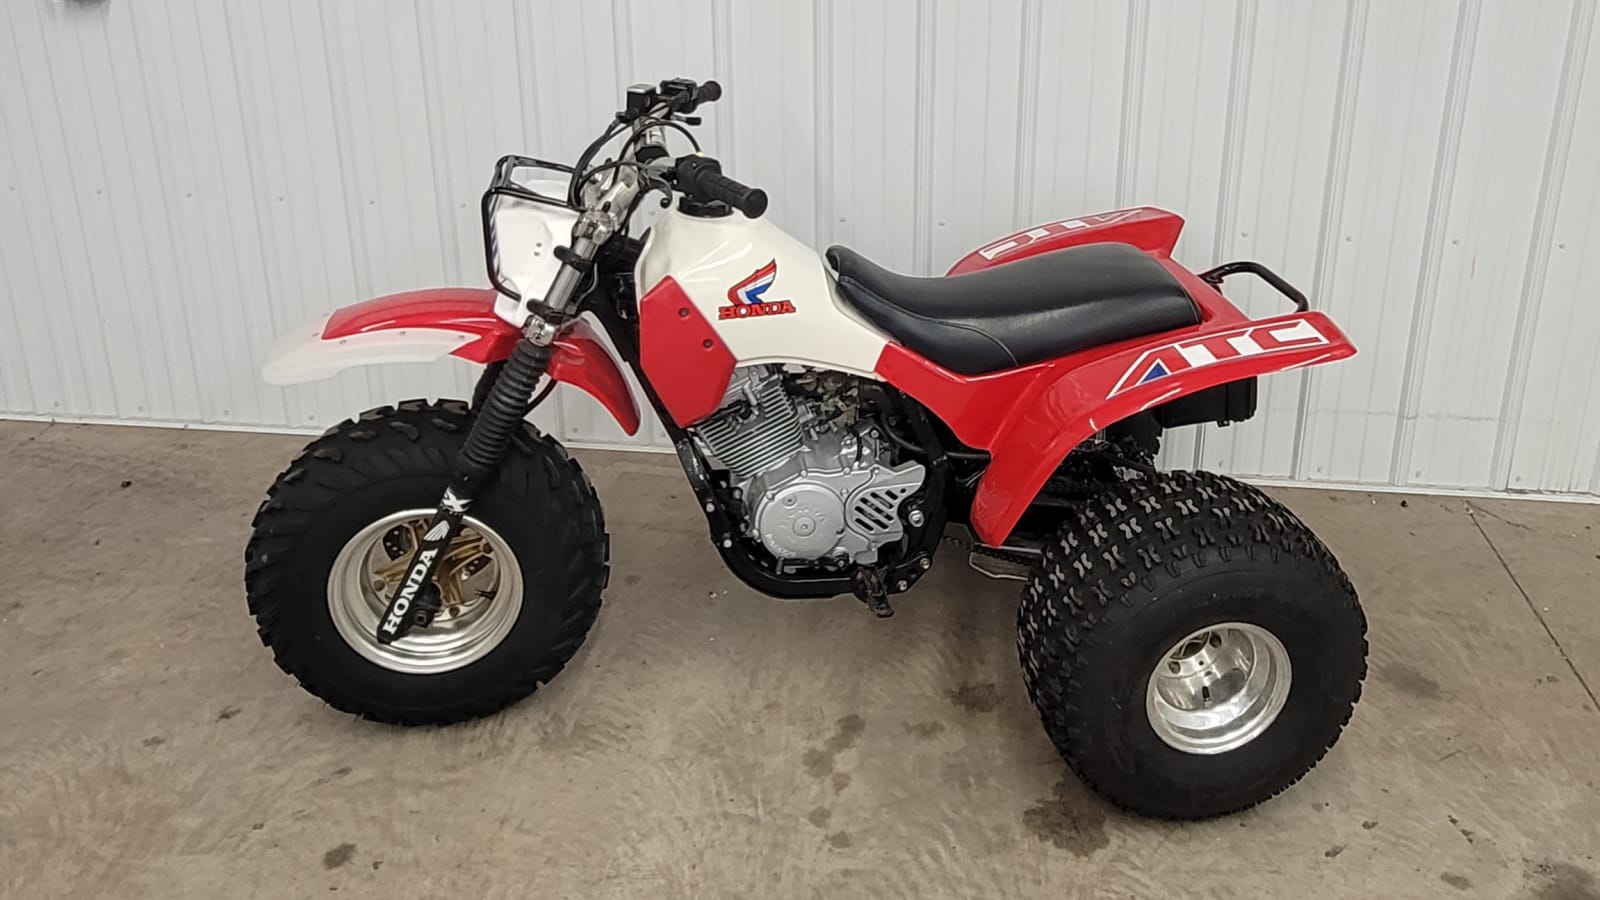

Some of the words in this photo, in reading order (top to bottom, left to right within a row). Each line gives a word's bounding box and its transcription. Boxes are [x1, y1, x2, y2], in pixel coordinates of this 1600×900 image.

[718, 299, 796, 320] HONDA
[1106, 319, 1330, 400] ATC
[382, 549, 438, 634] HONDA
